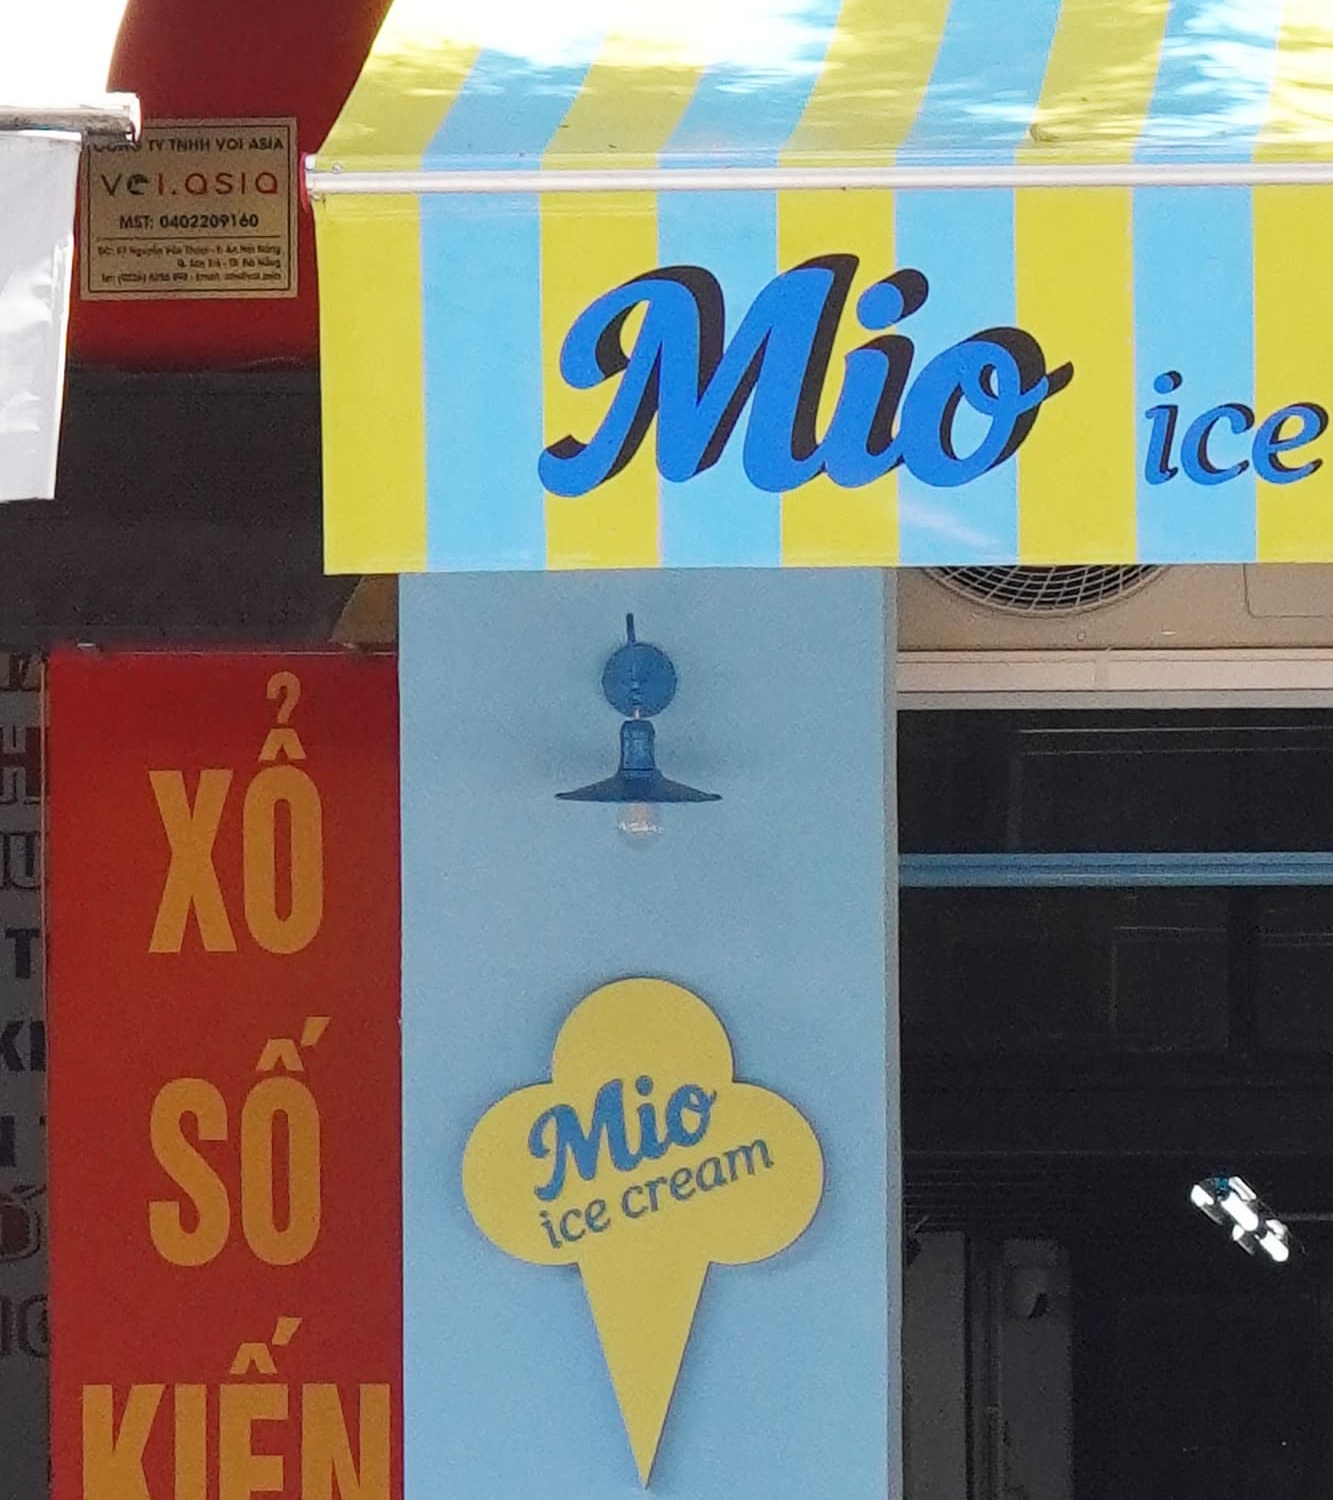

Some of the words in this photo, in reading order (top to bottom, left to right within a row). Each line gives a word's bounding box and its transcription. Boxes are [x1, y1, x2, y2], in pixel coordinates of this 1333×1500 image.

[249, 137, 284, 150] ASIA
[538, 254, 1074, 498] Mio
[1145, 370, 1328, 485] ice
[148, 671, 323, 954] XỔ
[149, 1016, 331, 1266] SỐ
[528, 1075, 718, 1201] Mio
[539, 1198, 612, 1249] ice
[620, 1138, 774, 1218] cream
